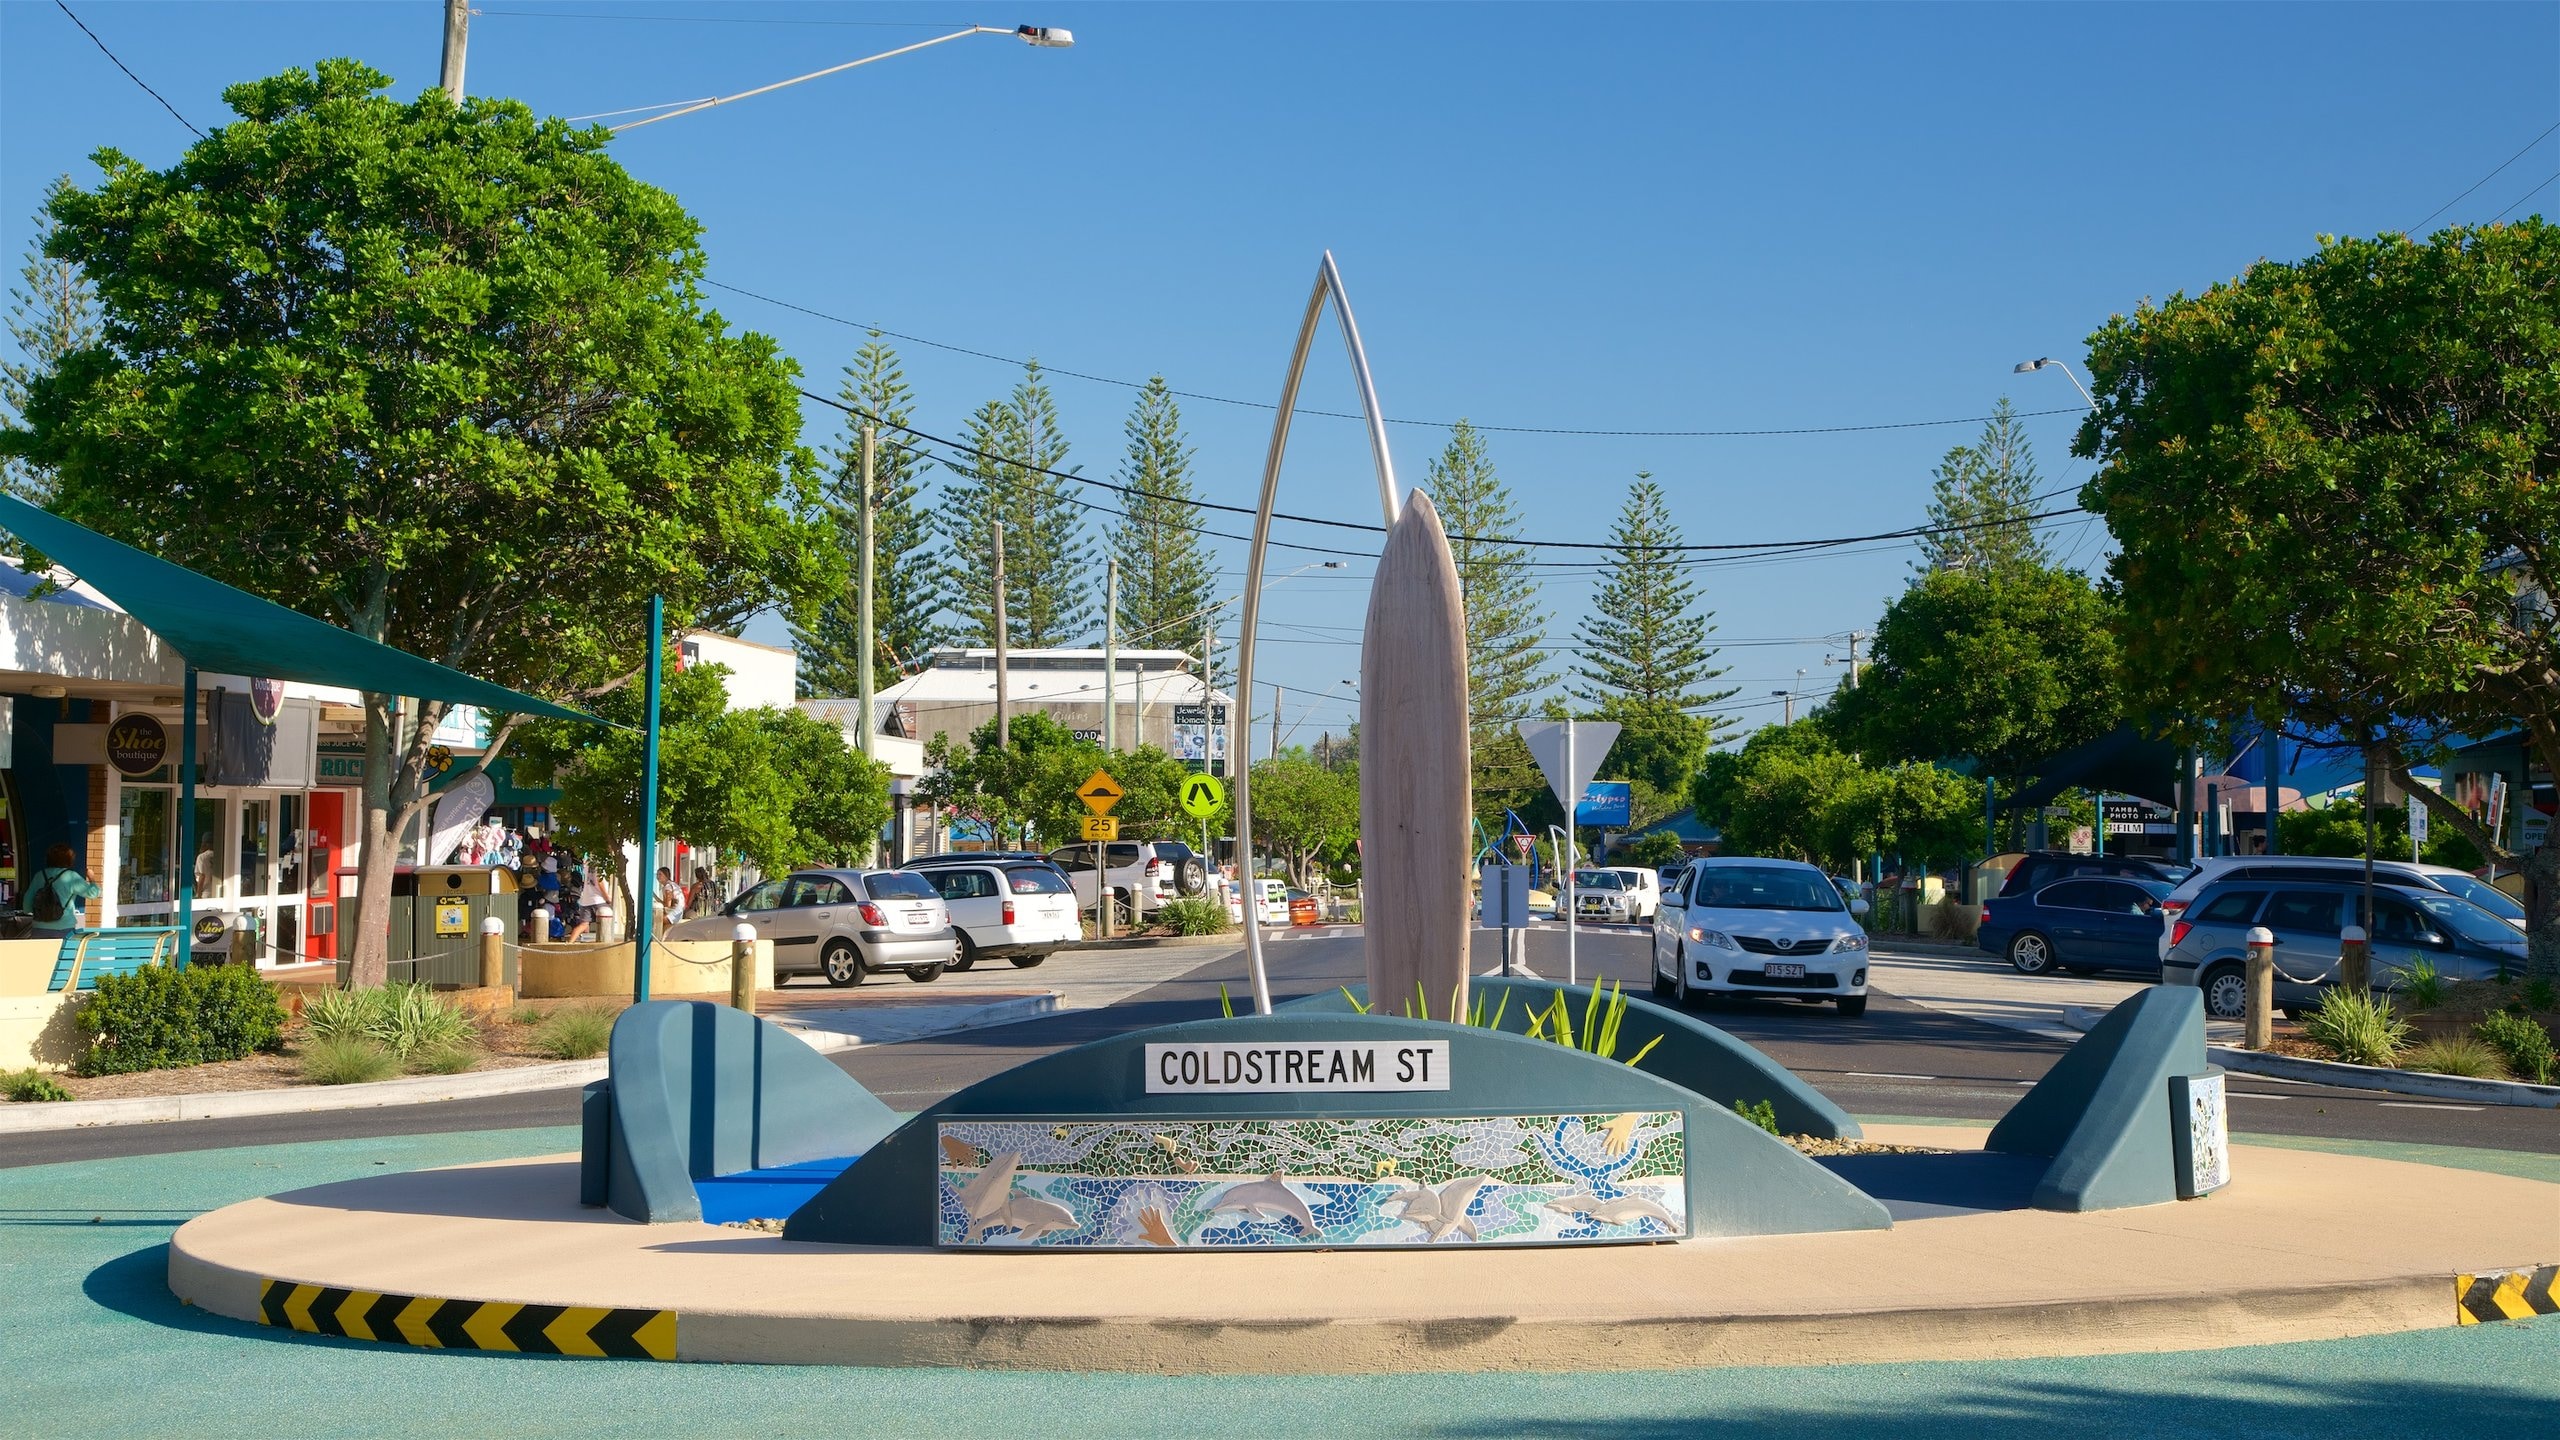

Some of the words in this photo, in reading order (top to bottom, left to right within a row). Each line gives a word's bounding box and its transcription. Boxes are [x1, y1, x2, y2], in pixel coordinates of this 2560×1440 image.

[112, 727, 164, 749] Shoe
[140, 728, 153, 736] the
[116, 750, 158, 761] boutique
[1090, 818, 1111, 832] 25
[1785, 965, 1804, 976] SZT
[1160, 1049, 1375, 1085] COLDSTREAM
[1396, 1048, 1434, 1083] ST
